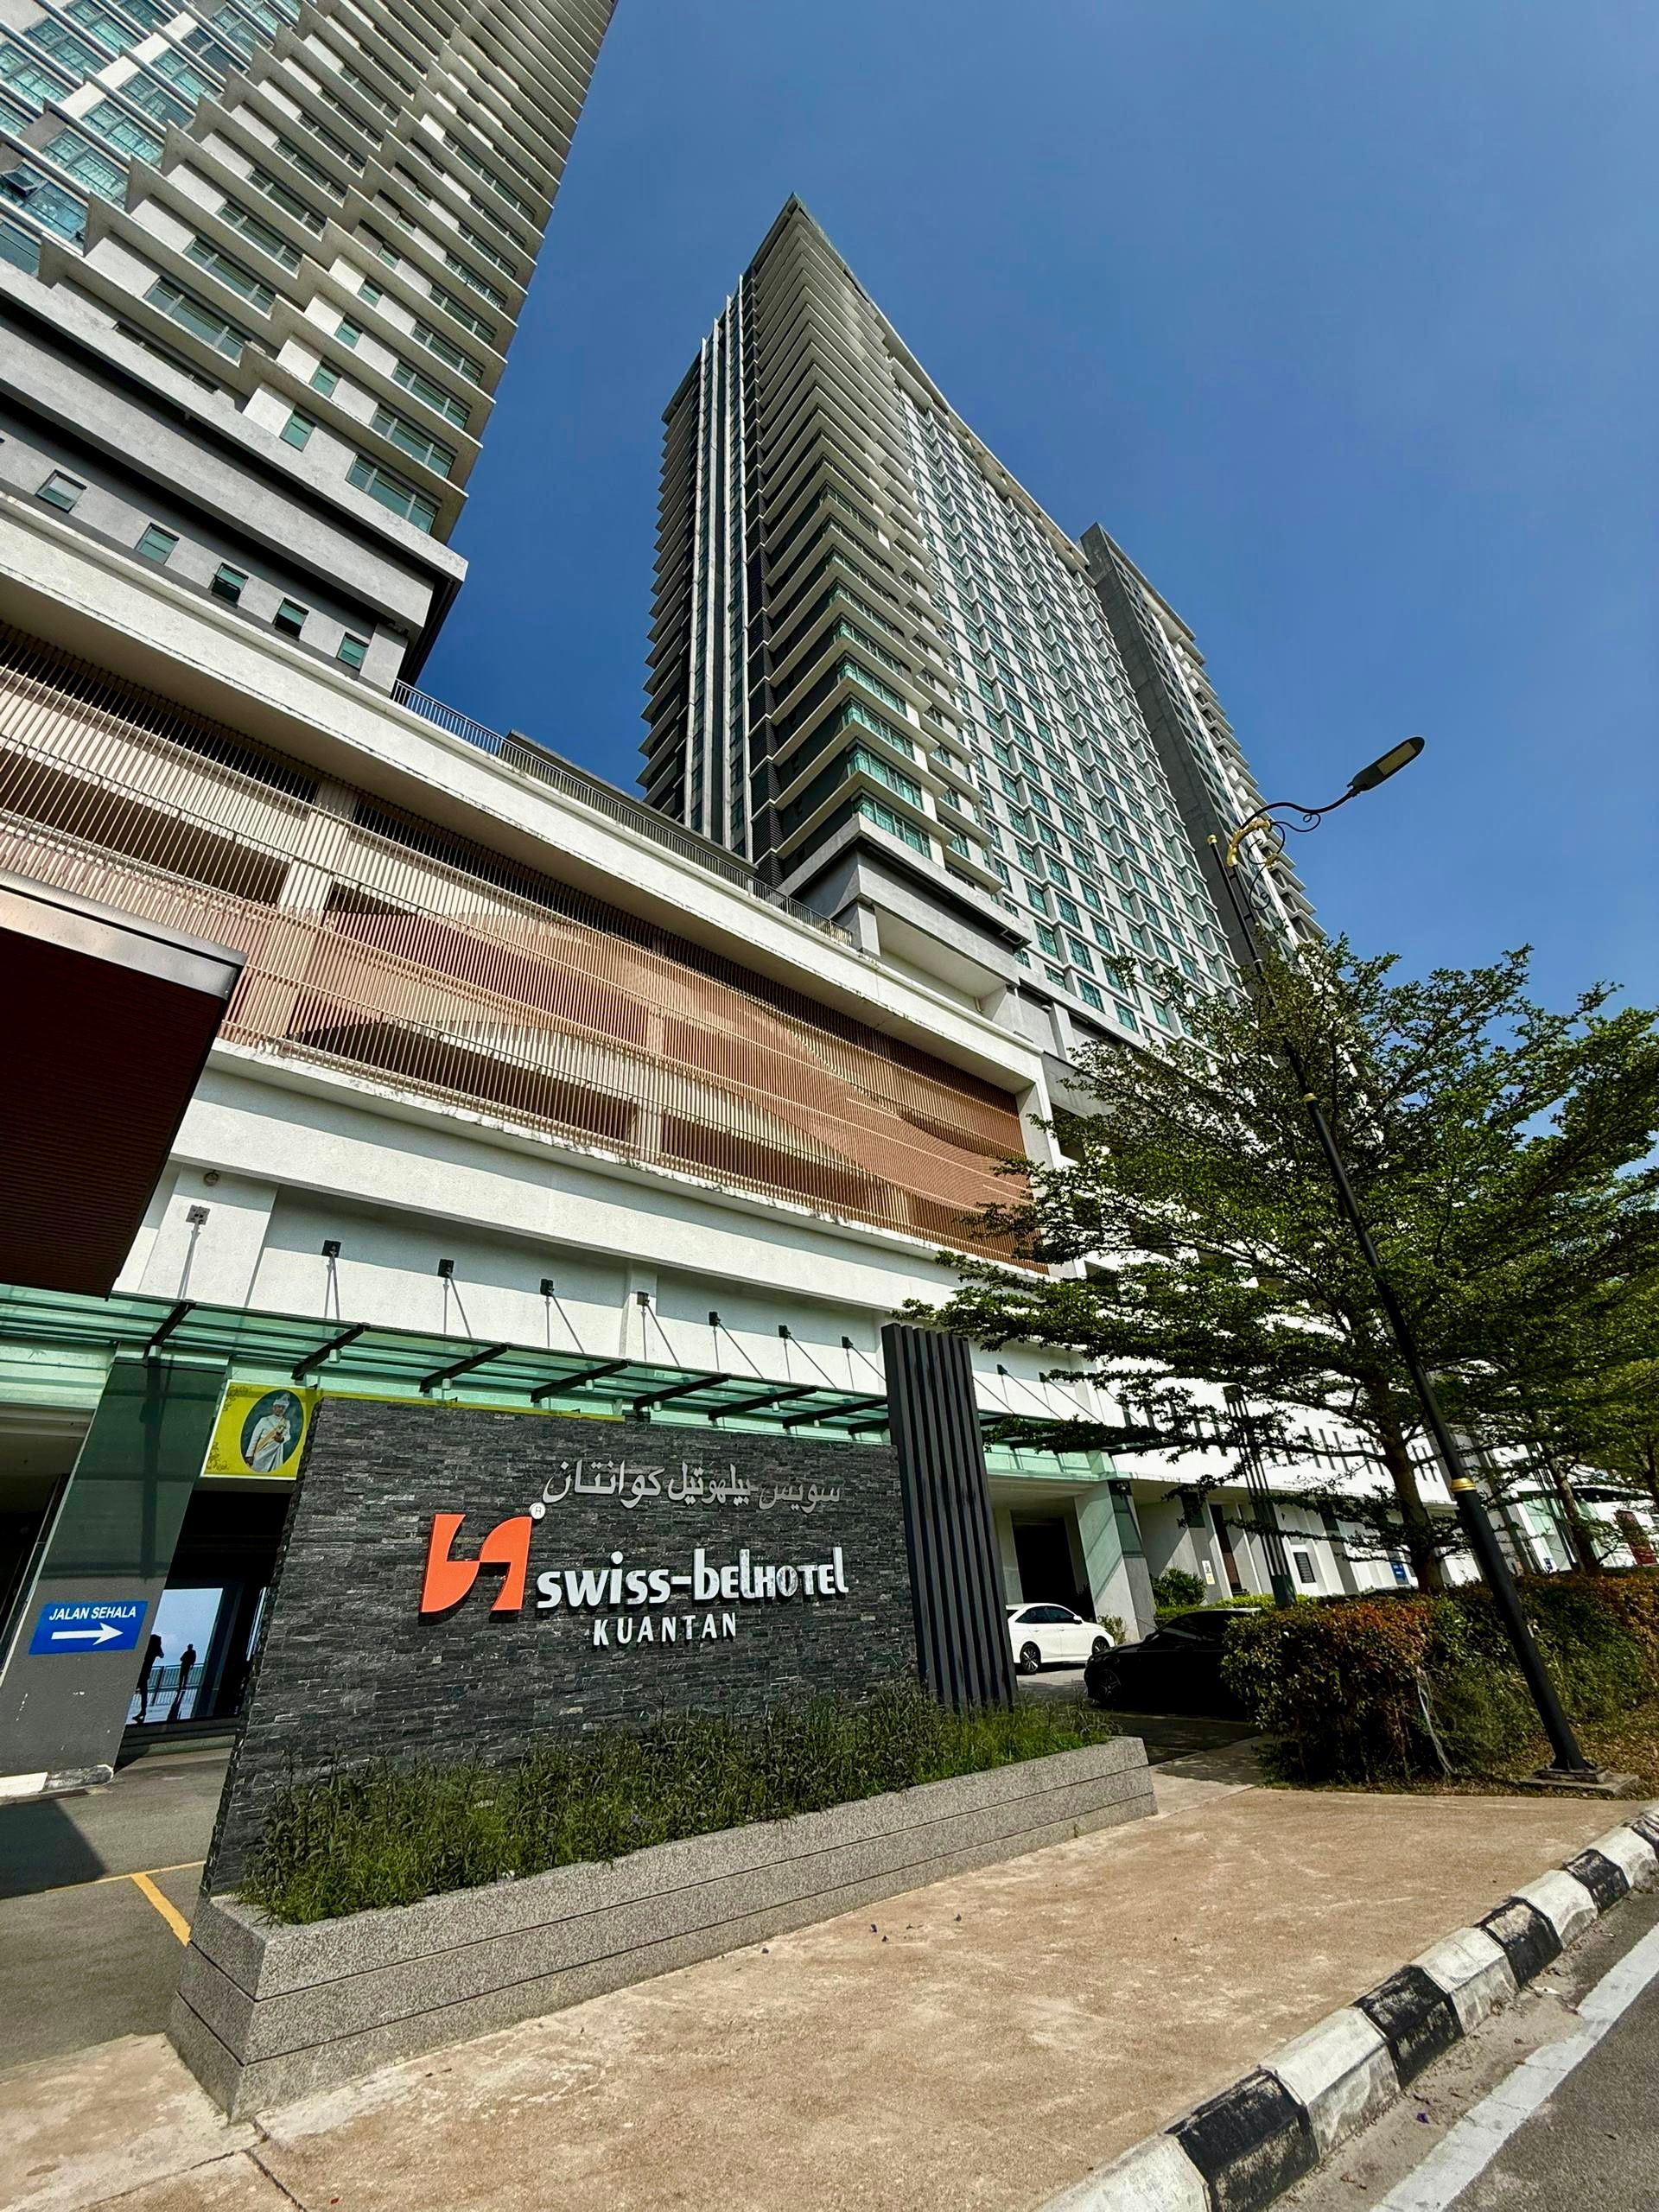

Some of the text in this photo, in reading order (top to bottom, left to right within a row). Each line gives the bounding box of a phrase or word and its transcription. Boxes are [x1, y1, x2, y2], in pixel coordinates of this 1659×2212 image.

[543, 1459, 665, 1509] كوانتان
[49, 1606, 137, 1621] JALAN SEHALA
[593, 1612, 736, 1646] KUANTAN
